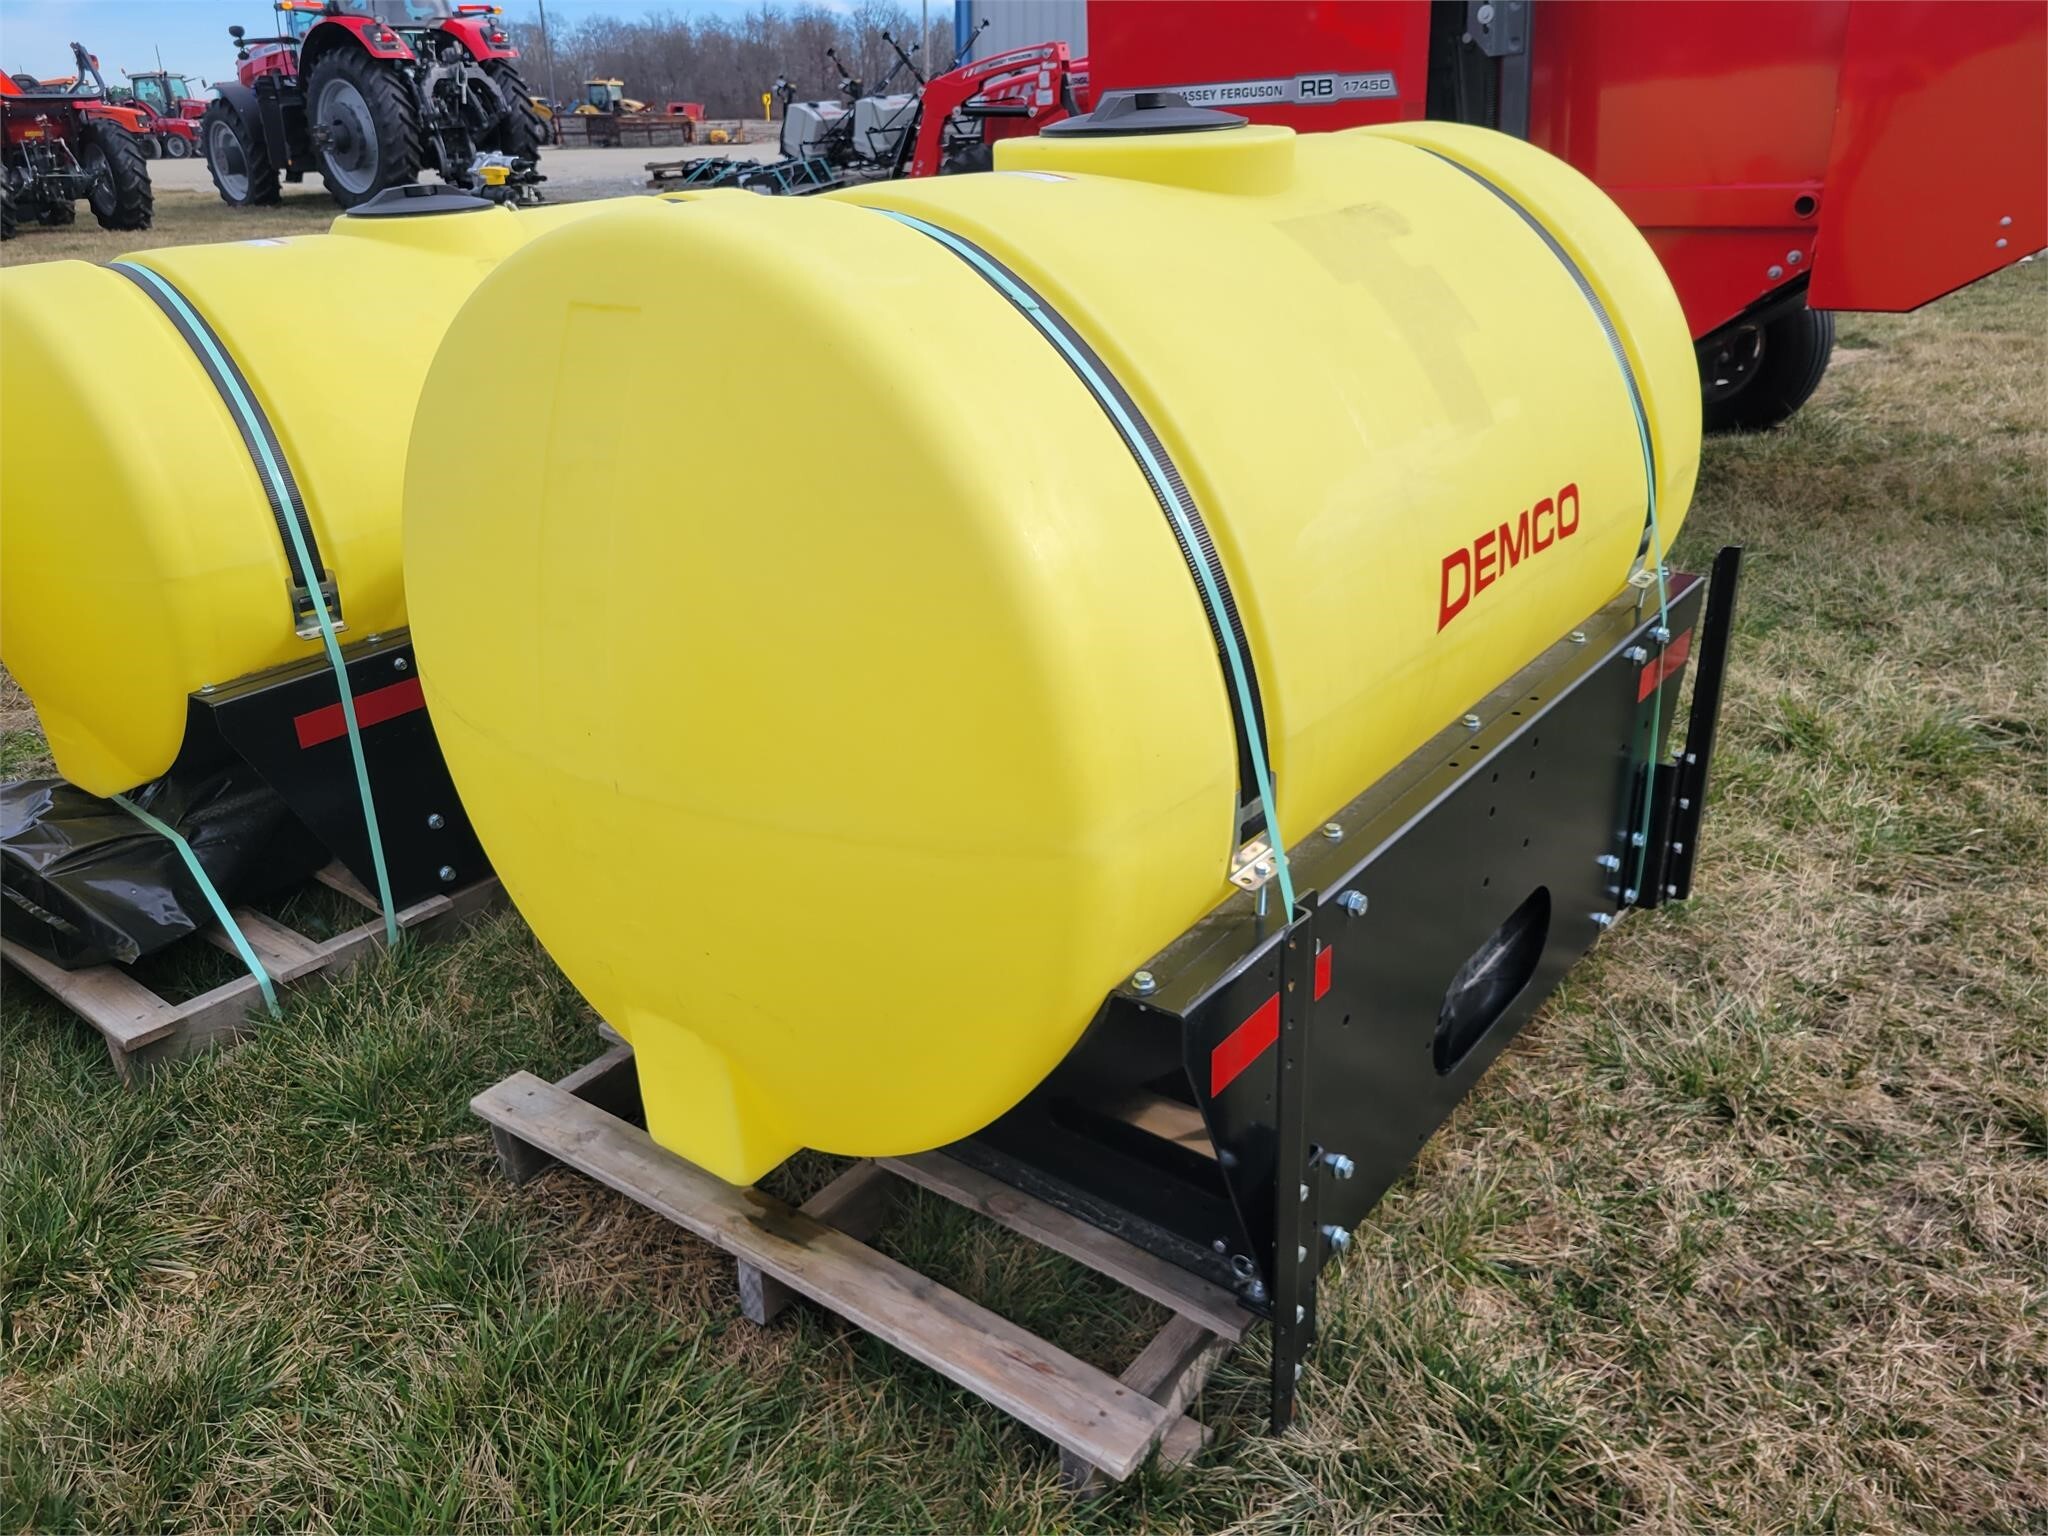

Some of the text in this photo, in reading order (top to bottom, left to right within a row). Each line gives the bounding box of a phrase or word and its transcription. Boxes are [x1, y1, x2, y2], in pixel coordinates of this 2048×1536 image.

[1177, 89, 1217, 101] ASSEY
[1220, 86, 1283, 100] FERGUSON
[1301, 79, 1333, 97] RB
[1437, 482, 1580, 635] DEMCO
